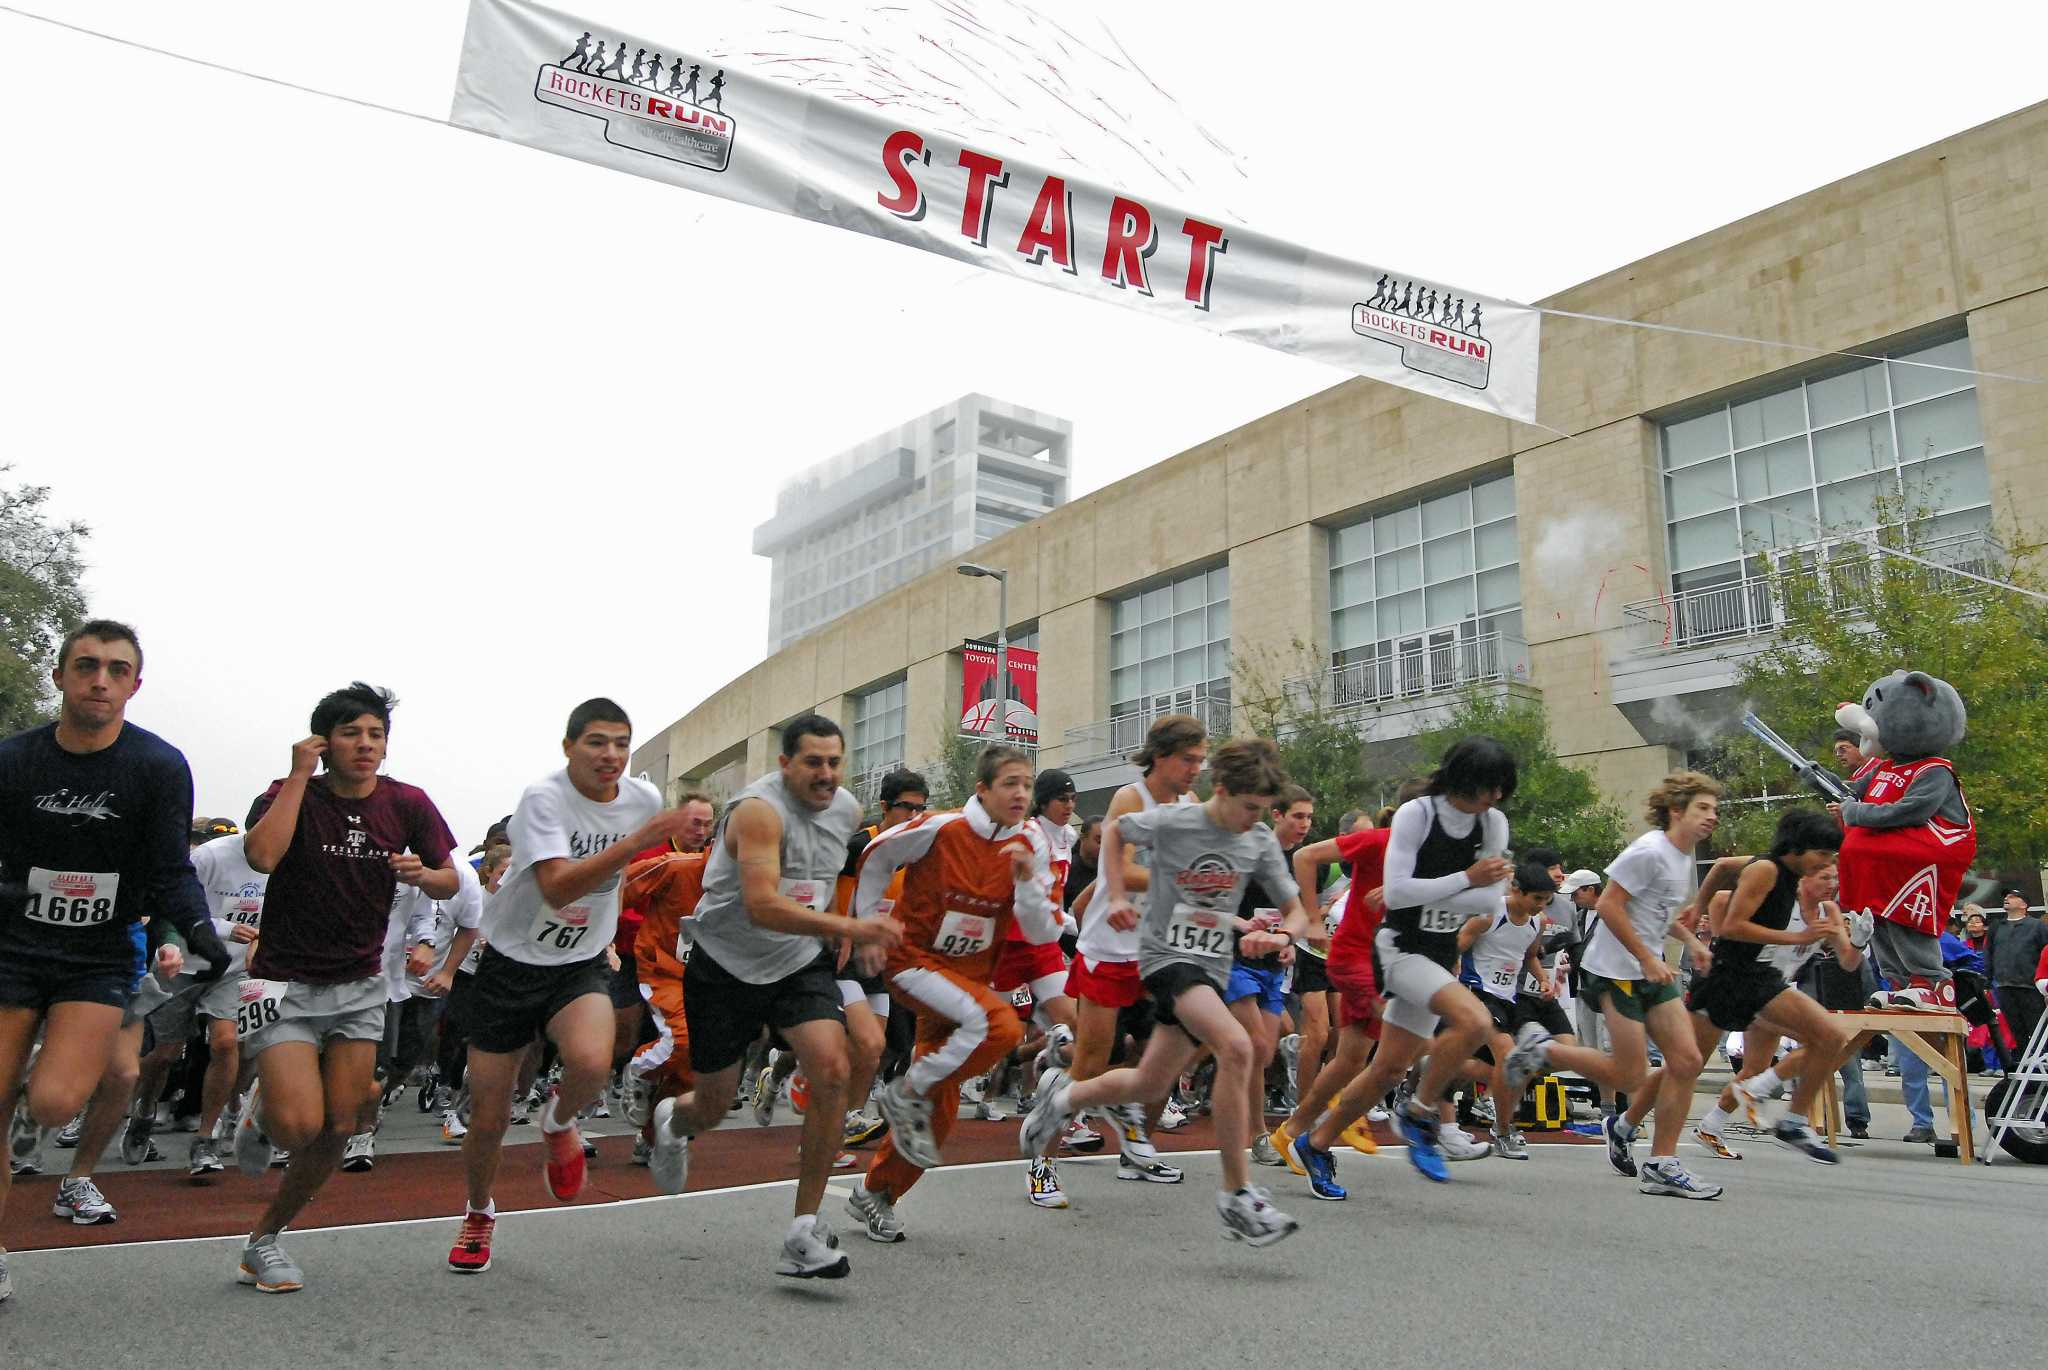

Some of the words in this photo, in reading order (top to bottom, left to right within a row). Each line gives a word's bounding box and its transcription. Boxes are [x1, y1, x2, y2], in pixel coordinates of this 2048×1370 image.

[550, 71, 641, 112] ROCKETS
[648, 97, 727, 132] RUN
[877, 130, 1228, 311] START
[1360, 309, 1426, 339] ROCKETS
[1429, 329, 1486, 359] RUN
[964, 653, 996, 665] TOYOTA
[1008, 660, 1037, 671] CENTER
[34, 789, 66, 809] The
[322, 844, 360, 855] TEXAS
[28, 893, 112, 923] 1668
[536, 920, 588, 949] 767
[943, 934, 985, 955] 935
[1168, 924, 1226, 953] 1542
[238, 998, 281, 1035] 598
